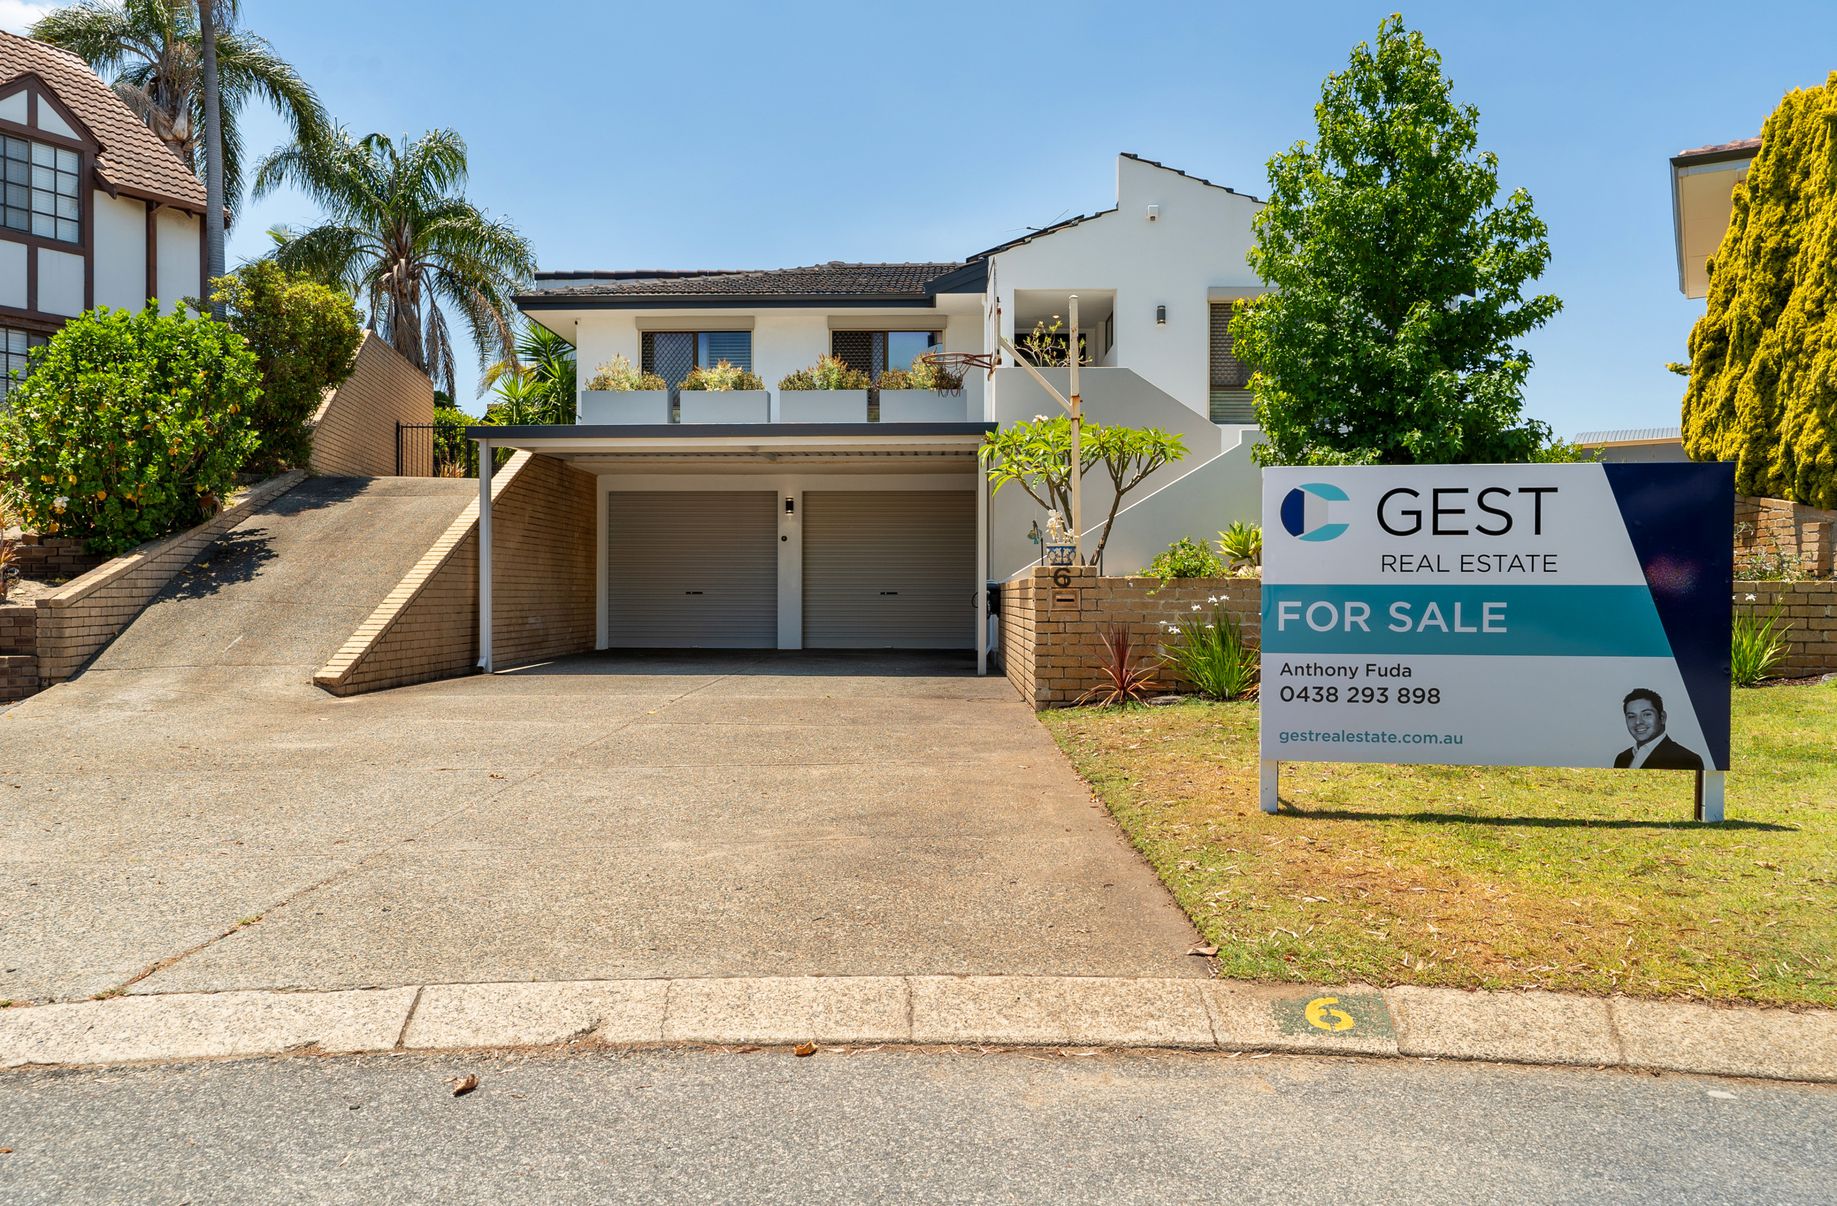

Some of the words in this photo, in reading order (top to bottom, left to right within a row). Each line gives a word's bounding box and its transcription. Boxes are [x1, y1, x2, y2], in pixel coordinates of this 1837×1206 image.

[1376, 486, 1559, 537] GEST
[1380, 553, 1450, 573] REAL
[1459, 554, 1558, 573] ESTATE
[1053, 567, 1071, 588] 6
[1277, 601, 1371, 632] FOR
[1388, 601, 1508, 633] SALE
[1279, 662, 1359, 680] Anthony
[1365, 663, 1413, 679] Fuda
[1279, 686, 1339, 703] 0438
[1347, 686, 1389, 704] 293
[1397, 687, 1441, 705] 898
[1279, 729, 1464, 746] gestrealestate.com.au
[1304, 996, 1356, 1032] 6
